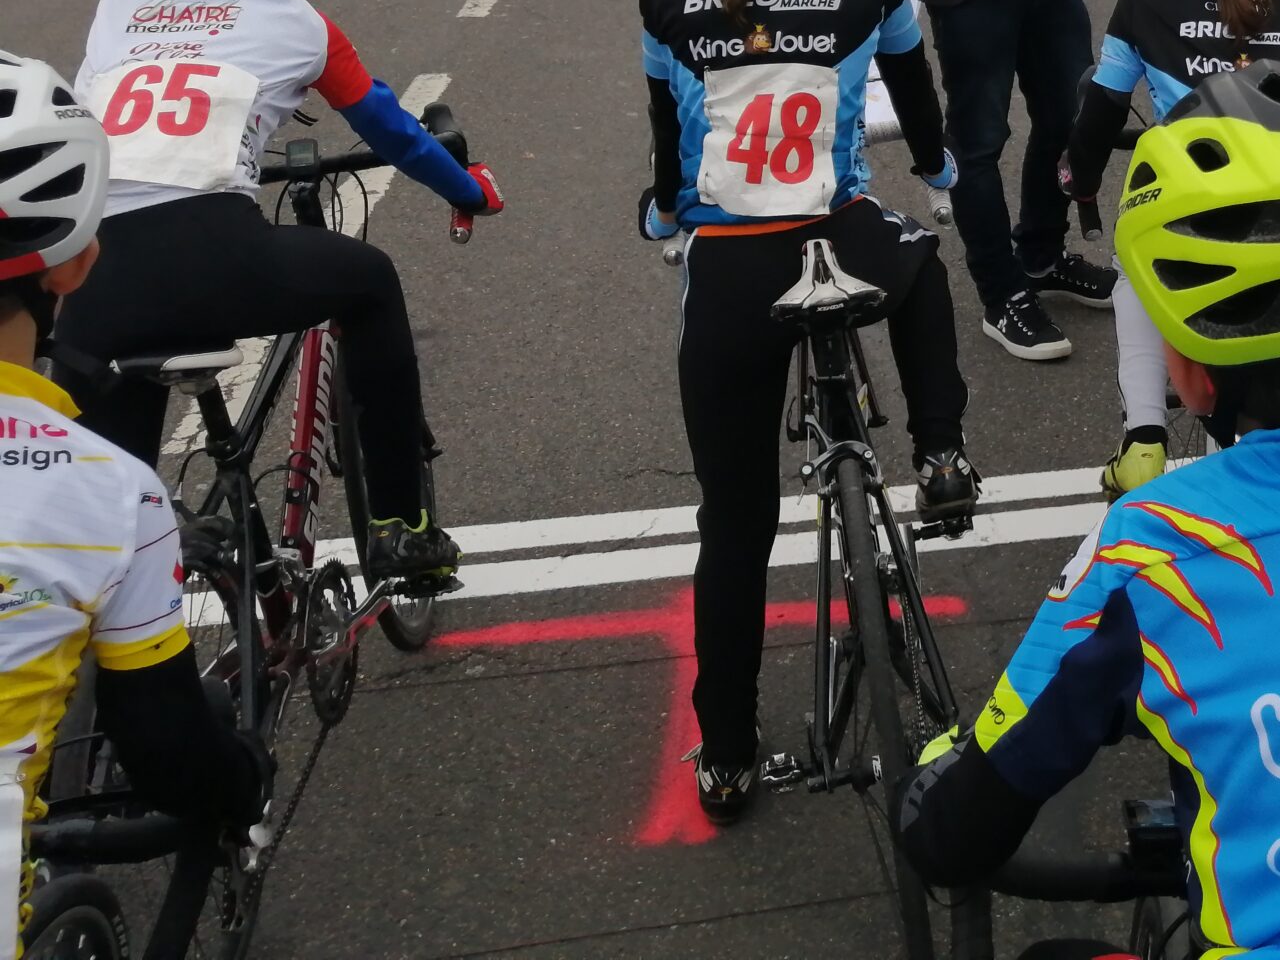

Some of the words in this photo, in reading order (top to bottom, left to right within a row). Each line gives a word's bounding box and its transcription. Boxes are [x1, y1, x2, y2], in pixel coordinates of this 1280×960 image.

[688, 34, 745, 61] King
[768, 30, 837, 54] Jouet
[103, 63, 221, 137] 65
[726, 92, 822, 185] 48
